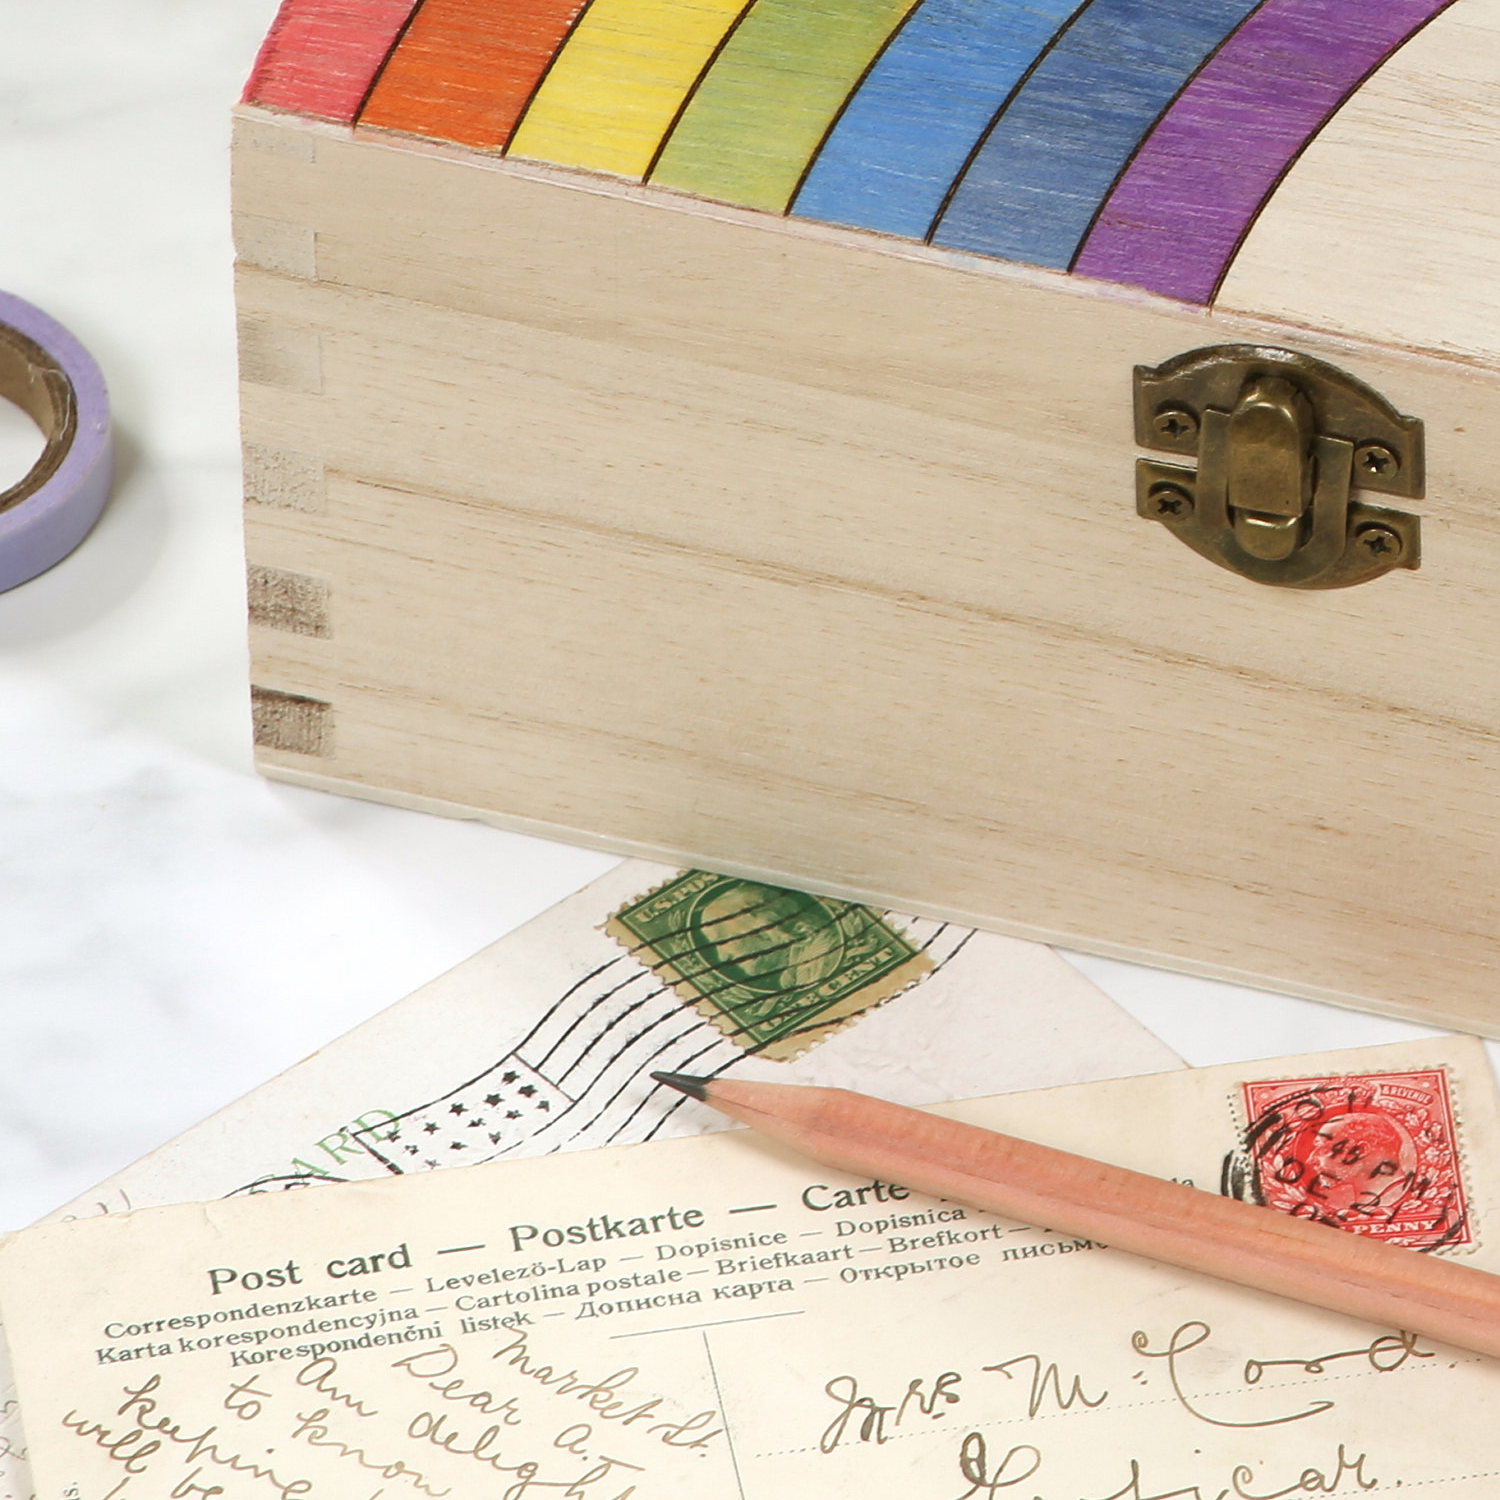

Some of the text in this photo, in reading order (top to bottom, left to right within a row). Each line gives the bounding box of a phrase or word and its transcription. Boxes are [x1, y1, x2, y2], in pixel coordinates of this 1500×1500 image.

[207, 1180, 911, 1296] Post card Postkarte Carte
[1352, 1219, 1438, 1236] PENNY
[96, 1224, 1003, 1364] Karta korespondencyjna Cartolina postale Briefkaart Brefkort
[104, 1287, 377, 1339] Correspondenzkarte
[655, 1231, 788, 1261] Dopisnice
[835, 1205, 967, 1237] Dopisnica
[574, 1289, 702, 1320] Дописна
[712, 1277, 795, 1300] карта
[839, 1252, 981, 1284] Открытое
[229, 1310, 537, 1367] Korespondenčni listek
[224, 1374, 272, 1420] to
[391, 1343, 522, 1425] Dear
